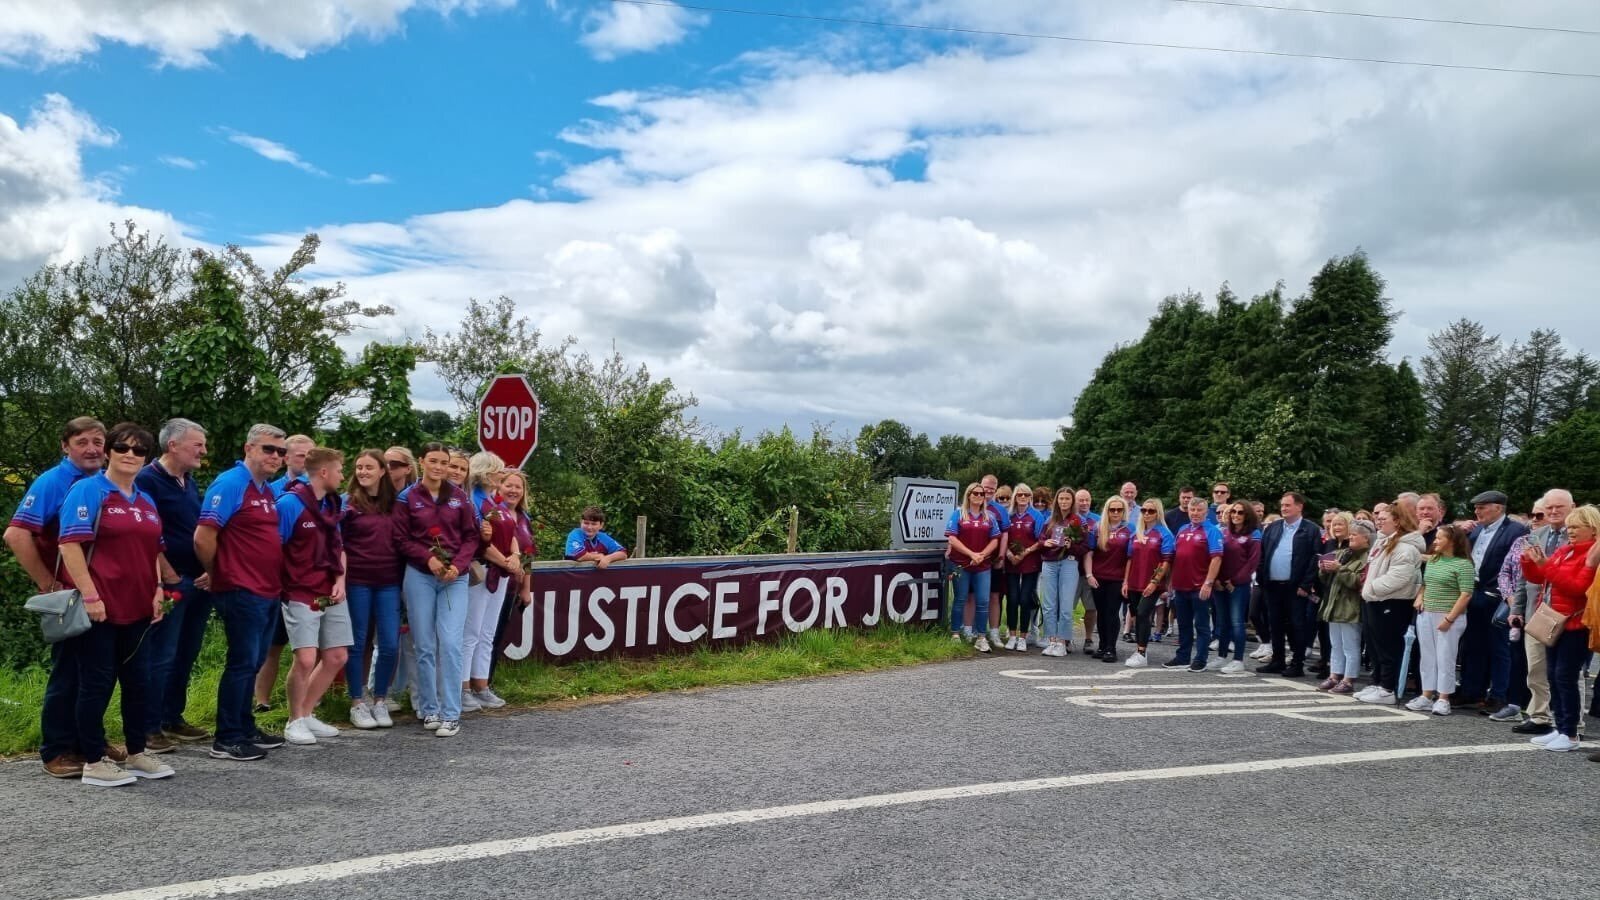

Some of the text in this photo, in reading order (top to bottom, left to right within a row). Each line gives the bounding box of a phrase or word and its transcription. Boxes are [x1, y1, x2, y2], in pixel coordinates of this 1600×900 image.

[483, 405, 533, 441] STOP
[915, 509, 943, 520] KINAFFE
[913, 526, 934, 538] L1901
[503, 571, 939, 661] JUSTICE FOR JOE
